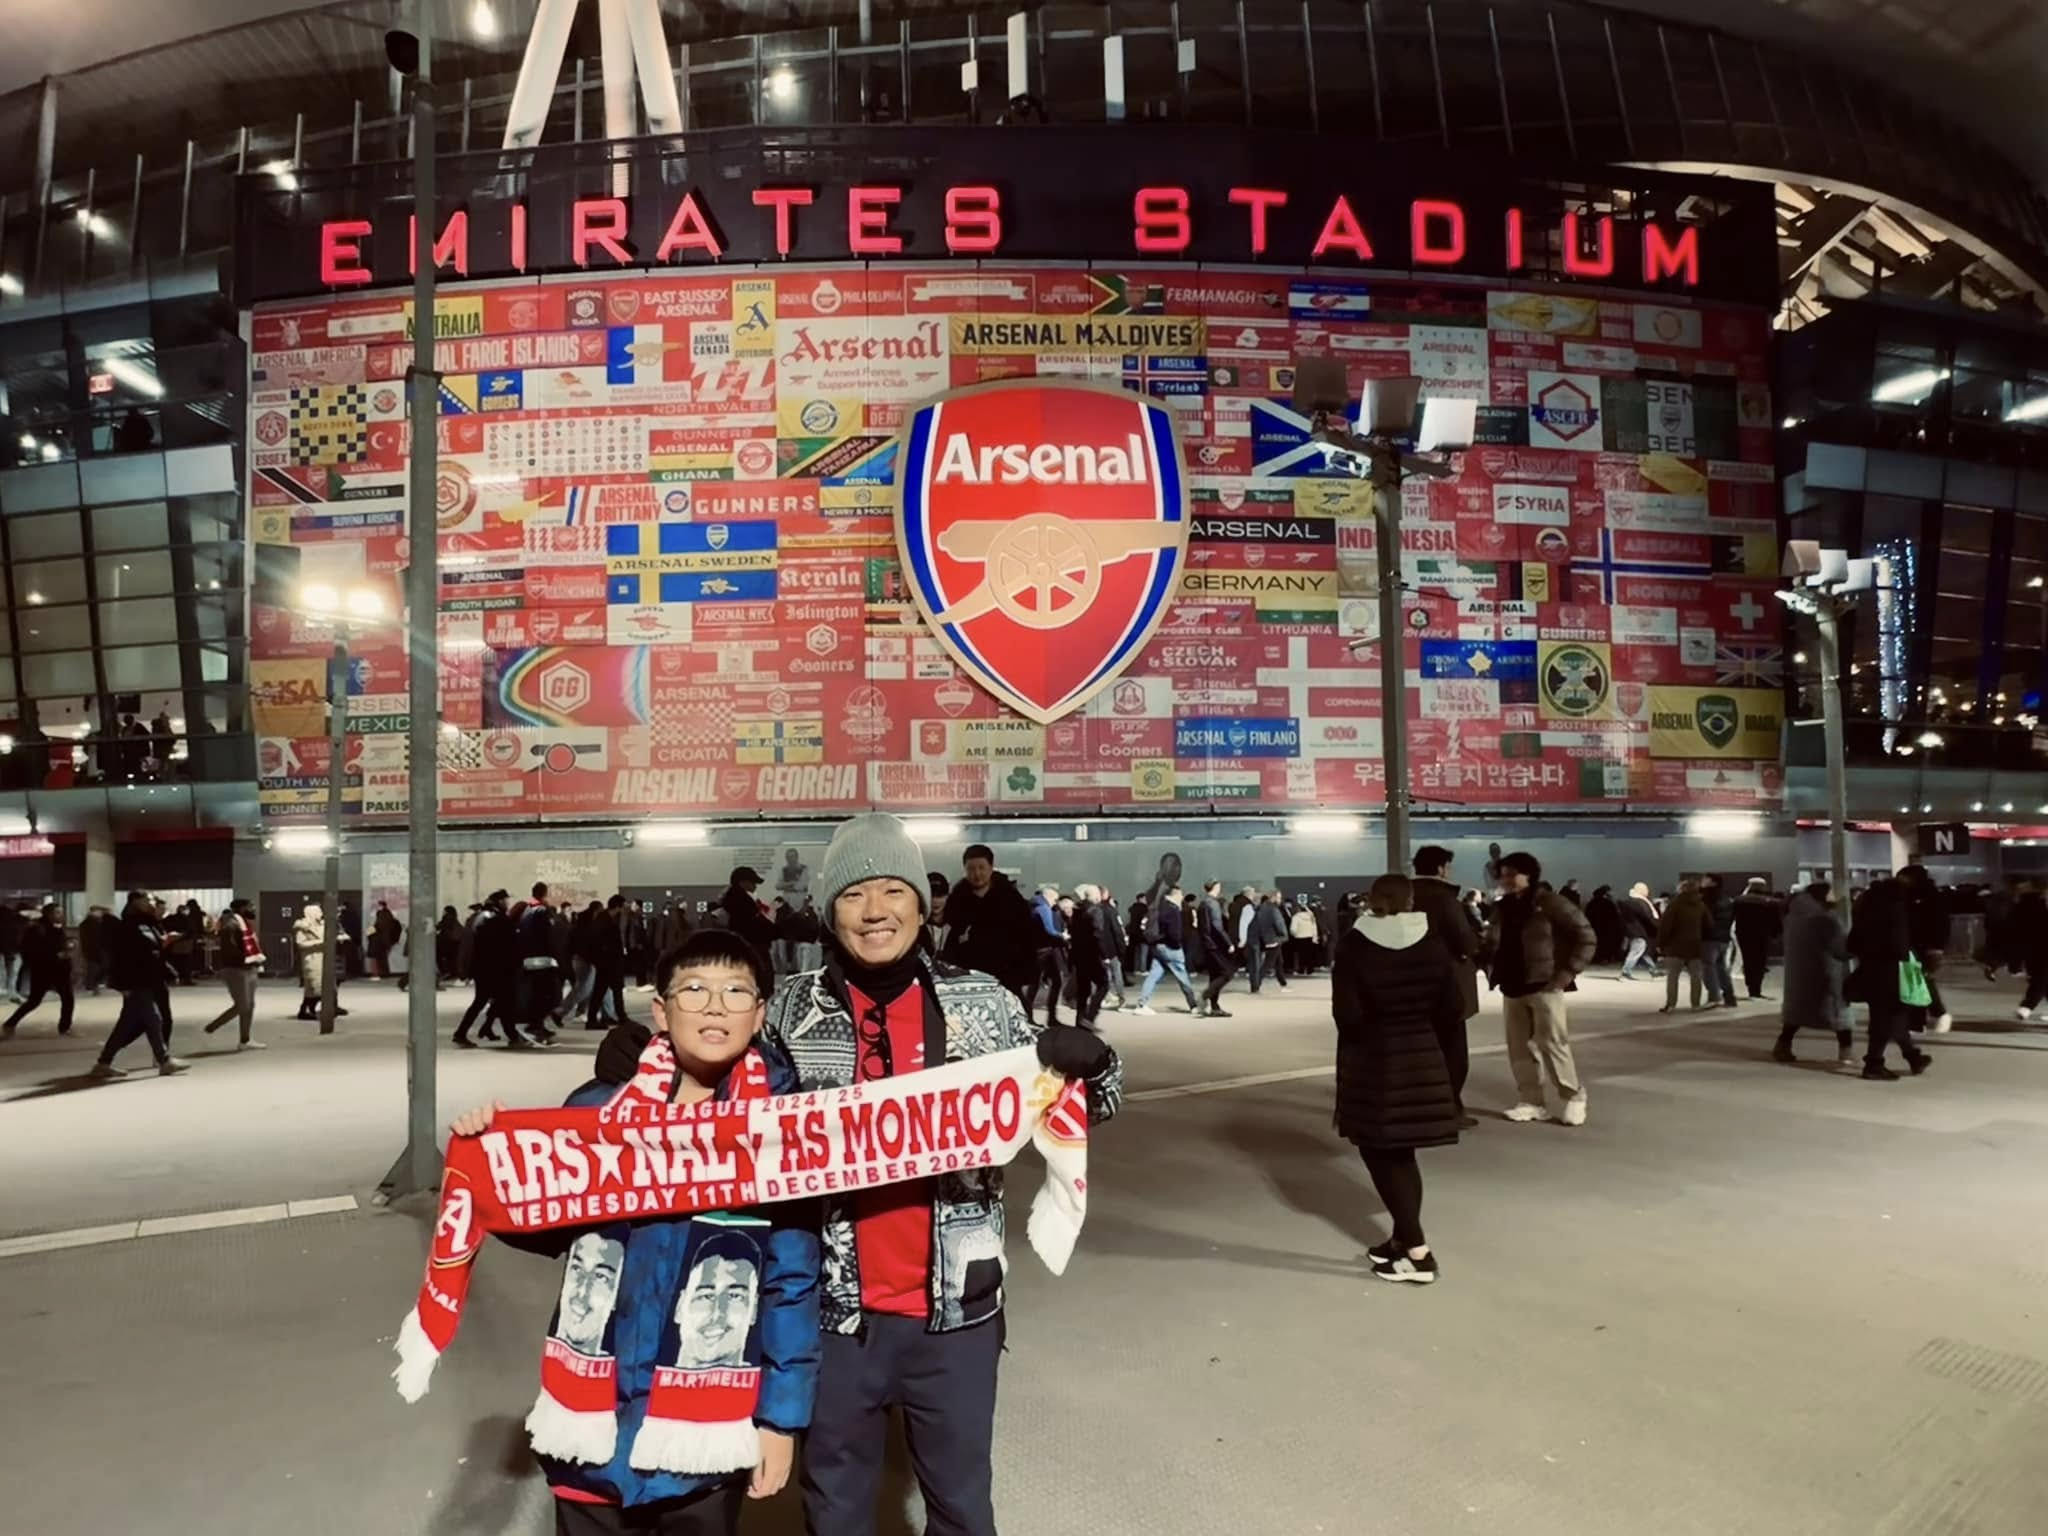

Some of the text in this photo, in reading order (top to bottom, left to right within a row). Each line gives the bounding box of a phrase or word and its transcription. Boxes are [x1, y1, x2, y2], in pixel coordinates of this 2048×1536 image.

[321, 186, 1699, 285] EMIRATES STADIUM
[1166, 287, 1256, 305] FERMANAGH
[656, 303, 718, 318] ARSENAL
[406, 311, 482, 341] ATRALIA
[962, 323, 1193, 346] ARSENAL MALDIVES
[781, 320, 944, 367] Arsenal
[256, 345, 364, 369] ARSENAL AMERICA
[463, 339, 509, 370] FAROE
[513, 335, 581, 367] ISLANDS
[1157, 360, 1197, 369] ARSENAL
[1422, 378, 1486, 391] ORKSHIRE
[673, 428, 753, 441] GUNNERS
[1259, 433, 1303, 442] ARSENAL
[654, 443, 729, 454] ARSENAL
[255, 453, 288, 467] ESSEX
[935, 432, 1148, 484] Arsenal
[661, 470, 721, 481] GHANA
[598, 485, 657, 505] ARSENAL
[695, 495, 816, 515] GUNNERS
[1514, 496, 1566, 513] SYRIA
[1190, 520, 1321, 539] ARSENAL
[1338, 527, 1456, 551] INDNESIA
[613, 554, 773, 570] ARSENAL SWEDEN
[780, 567, 861, 588] Kerala
[1183, 573, 1326, 591] GERMANY
[785, 603, 859, 621] Islington
[1469, 601, 1526, 613] ARSENAL
[1261, 624, 1333, 636] LITHUANIA
[1539, 627, 1607, 641] GUNNERS
[1161, 646, 1224, 657] CZECH
[788, 658, 855, 673] Gooners
[1163, 656, 1238, 668] SLOVAK
[653, 686, 732, 701] ARSENAL
[1324, 697, 1382, 707] COPENHAGE
[344, 716, 411, 732] MEXIC
[965, 721, 1034, 732] ARSENAL
[1652, 712, 1694, 731] ARSENAL
[1176, 729, 1298, 746] ARSENAL FINLAND
[657, 747, 730, 762] CROATIA
[965, 746, 1034, 757] ARE MAGIC
[1099, 743, 1163, 757] Gooners
[369, 773, 410, 786] ARSE
[611, 767, 720, 804] ARSENAL
[756, 763, 858, 802] GEORGIA
[1187, 785, 1249, 798] HUNGARY
[269, 803, 329, 815] GUNNER
[365, 800, 410, 813] PAKIS
[1935, 830, 1954, 852] N
[598, 1103, 641, 1124] CH.
[650, 1099, 748, 1122] LEAGUE
[479, 1121, 737, 1206] ARSNAL
[778, 1109, 831, 1174] AS
[839, 1075, 1021, 1166] MONACO
[507, 1148, 993, 1227] WEDNESDAY 11TH DECEMBER 2024
[659, 1372, 755, 1390] MARTINELLI
